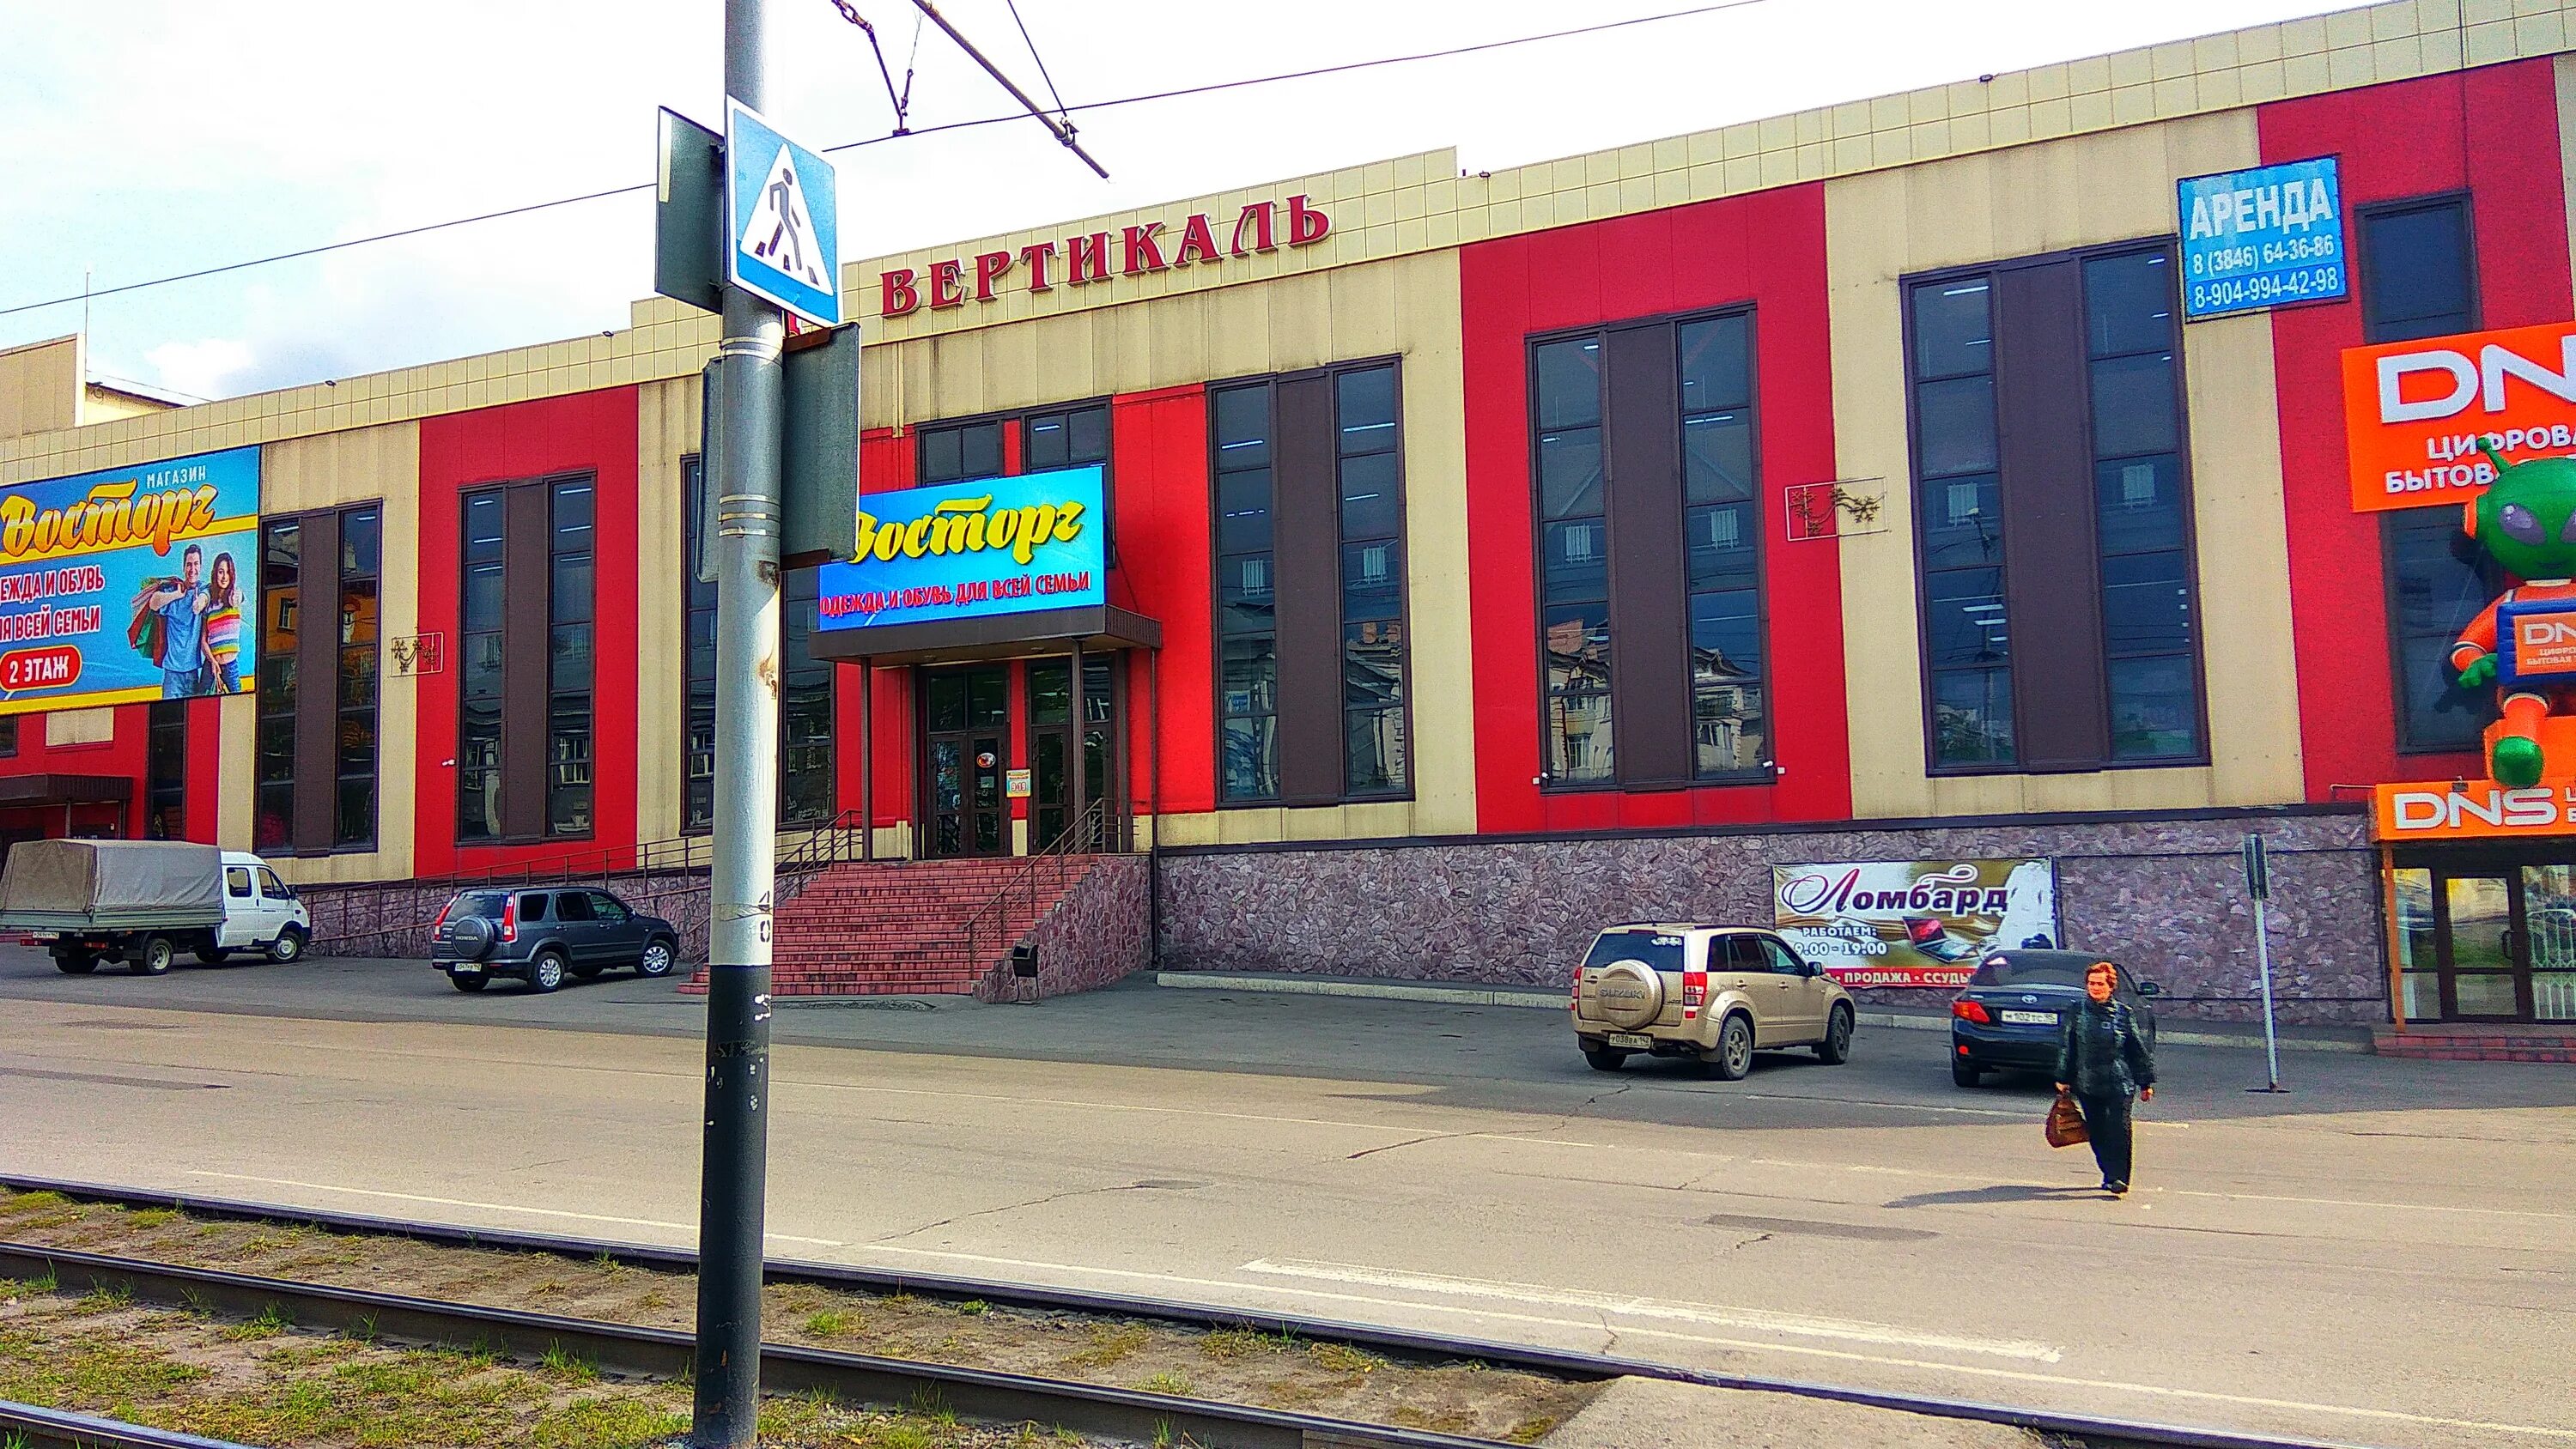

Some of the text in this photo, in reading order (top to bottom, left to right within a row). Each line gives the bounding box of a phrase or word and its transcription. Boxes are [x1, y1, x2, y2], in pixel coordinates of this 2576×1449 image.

[2190, 179, 2333, 240] АРЕНДА
[879, 194, 1334, 318] ВЕРТИКАЛЬ
[2193, 234, 2335, 276] 8 (3846) 64-36-86
[2194, 266, 2338, 309] 8-904-994-42-98
[2427, 424, 2576, 461] ЦИФРОВ
[146, 464, 207, 488] МАГАЗИН
[2385, 462, 2500, 494] БЫТОВ
[0, 479, 218, 558] Восторг
[45, 570, 56, 598] И
[58, 566, 105, 595] ОБУВЬ
[820, 571, 1091, 617] ОДЕЖДА И ОБУВЬ ДЛЯ ВСЕЙ СЕМЬИ
[15, 604, 51, 640] ВСЕЙ
[53, 606, 100, 636] СЕМЬИ
[9, 655, 70, 684] 2 ЭТАЖ
[2394, 788, 2557, 829] DNS
[1782, 864, 2008, 916] Ломбард
[1802, 926, 1878, 937] РАБОТАЕМ:
[1600, 987, 1645, 999] SUZUKI
[1844, 972, 1911, 984] ПРОДАЖА
